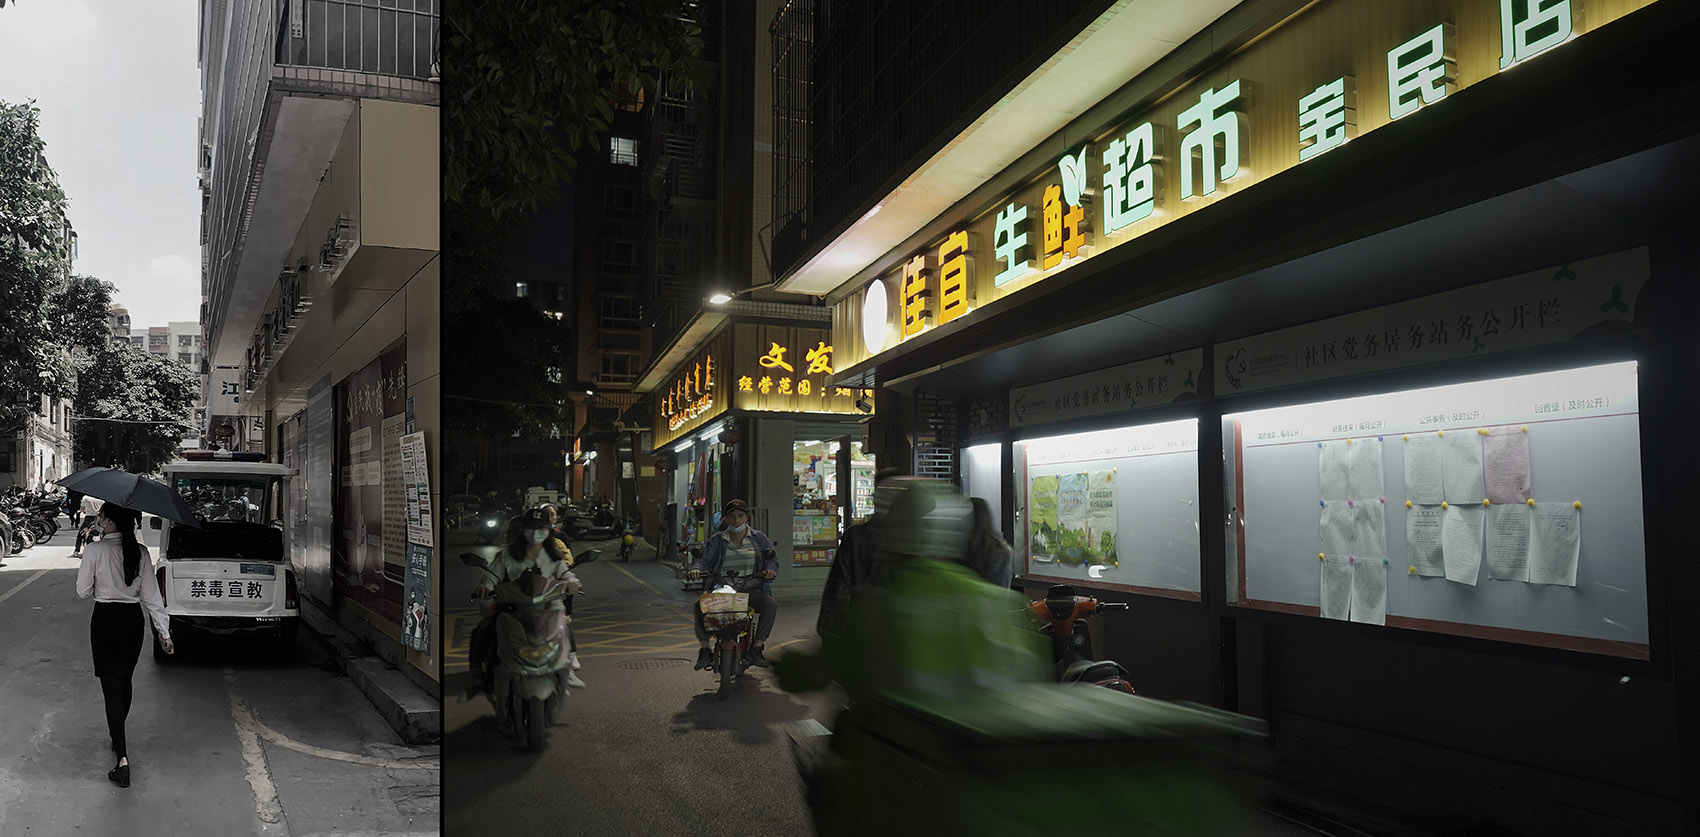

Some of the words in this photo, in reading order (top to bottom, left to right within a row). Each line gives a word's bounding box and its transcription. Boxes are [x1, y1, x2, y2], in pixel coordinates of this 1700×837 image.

[1305, 297, 1562, 369] 社区党务居务站务公开栏
[759, 341, 834, 375] 文发
[1054, 375, 1169, 412] 社区党务居务站务公开栏
[1534, 397, 1611, 414] 回音壁（及时公开）
[1419, 411, 1485, 424] 公共事务（及时公开）
[190, 579, 263, 599] 禁毒宣教
